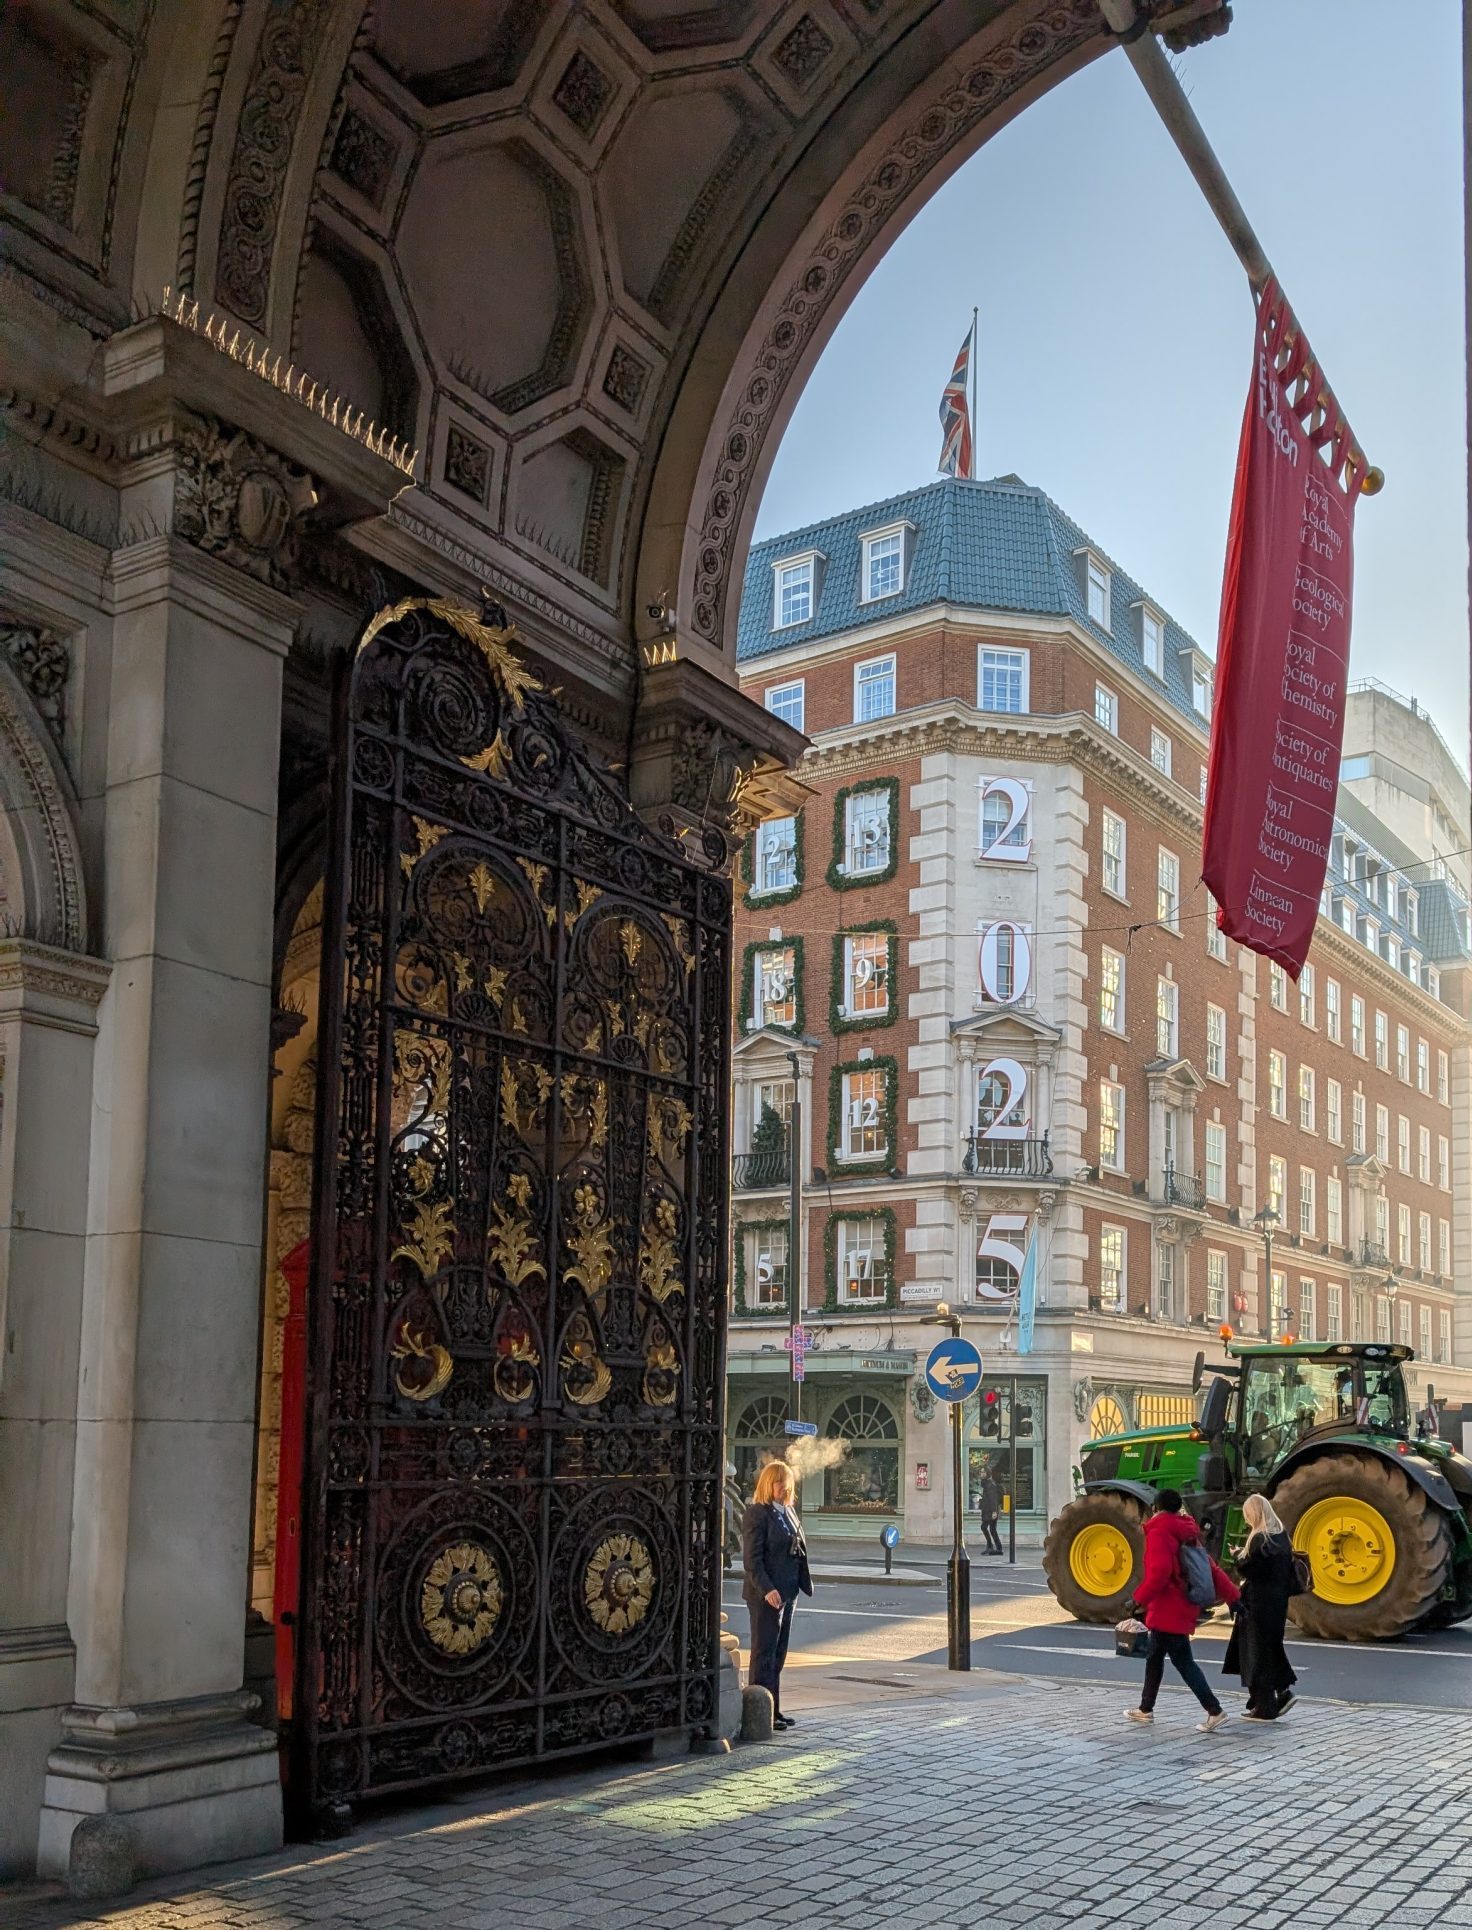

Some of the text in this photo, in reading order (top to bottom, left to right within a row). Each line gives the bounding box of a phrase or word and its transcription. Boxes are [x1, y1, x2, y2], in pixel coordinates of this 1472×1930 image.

[1300, 525, 1334, 561] f Arts
[1291, 588, 1332, 632] ociety
[1287, 631, 1315, 666] oyal
[1283, 653, 1337, 700] ociety of
[1313, 747, 1330, 766] of
[853, 814, 881, 849] 13
[1261, 810, 1329, 861] Astronomica
[1249, 874, 1293, 915] Linnean
[1244, 897, 1286, 937] Society
[761, 970, 787, 1001] 18
[855, 958, 874, 990] 9
[850, 1097, 879, 1128] 12
[757, 1253, 775, 1283] 5
[845, 1248, 872, 1280] 17
[902, 1287, 932, 1295] PICCADILLY
